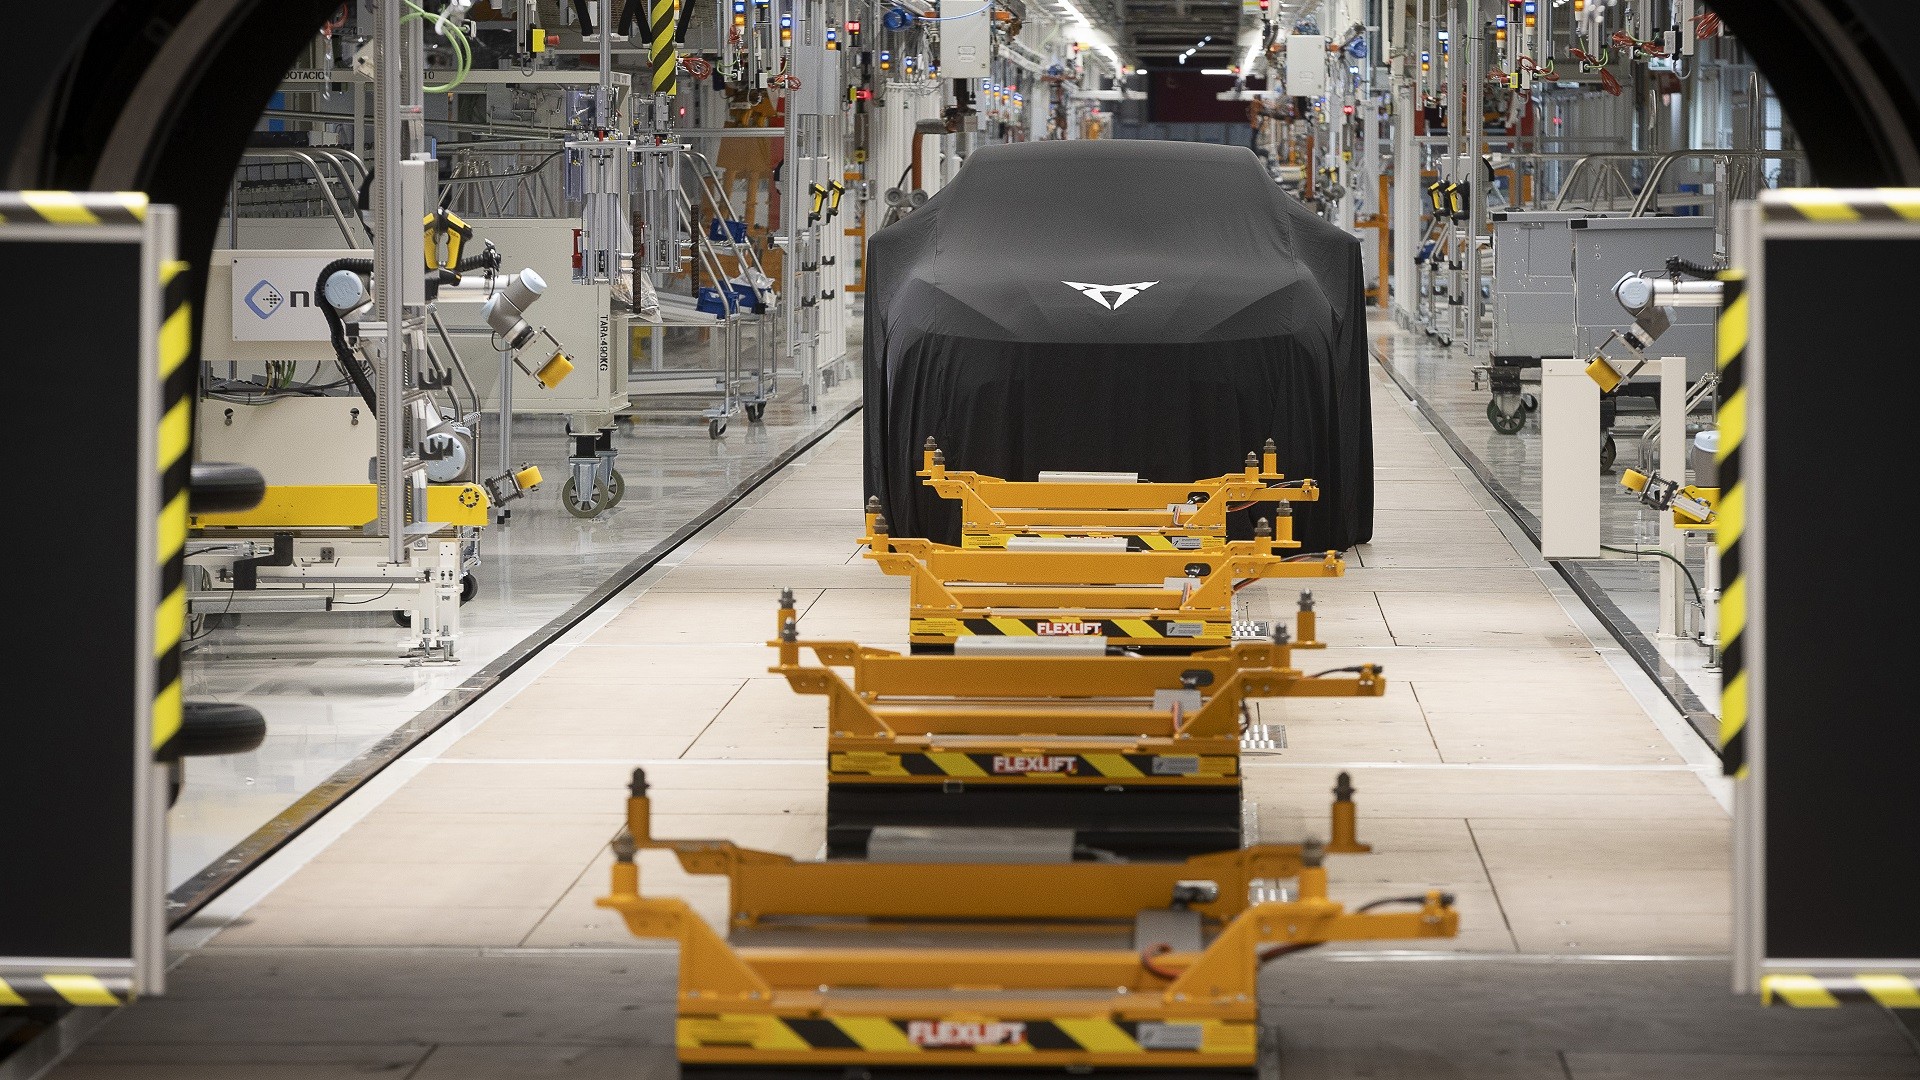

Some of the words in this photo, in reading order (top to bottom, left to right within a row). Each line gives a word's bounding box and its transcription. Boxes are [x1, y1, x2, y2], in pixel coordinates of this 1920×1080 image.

[1037, 622, 1102, 635] FLEXLIFT
[993, 756, 1077, 773] FLEXLIFT
[908, 1020, 1027, 1045] FLEXLIFT
